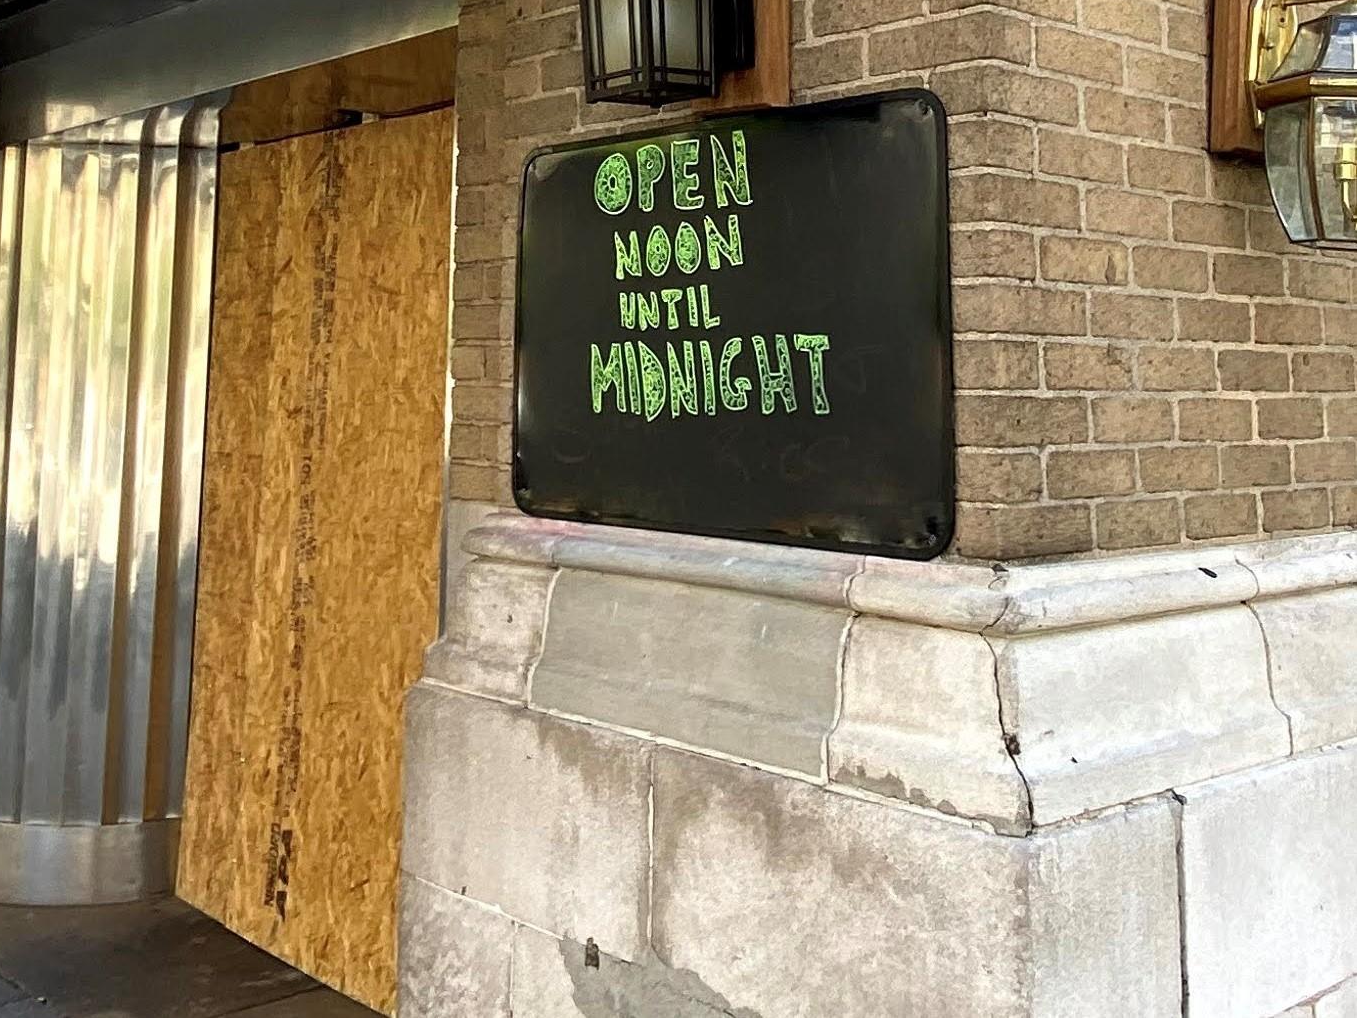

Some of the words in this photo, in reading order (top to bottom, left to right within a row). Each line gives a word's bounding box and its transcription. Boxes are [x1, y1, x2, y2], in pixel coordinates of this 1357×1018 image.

[594, 130, 753, 215] OPEN
[614, 214, 743, 279] NOON
[619, 284, 720, 331] UNTIL
[590, 333, 831, 422] MIDNIGHT
